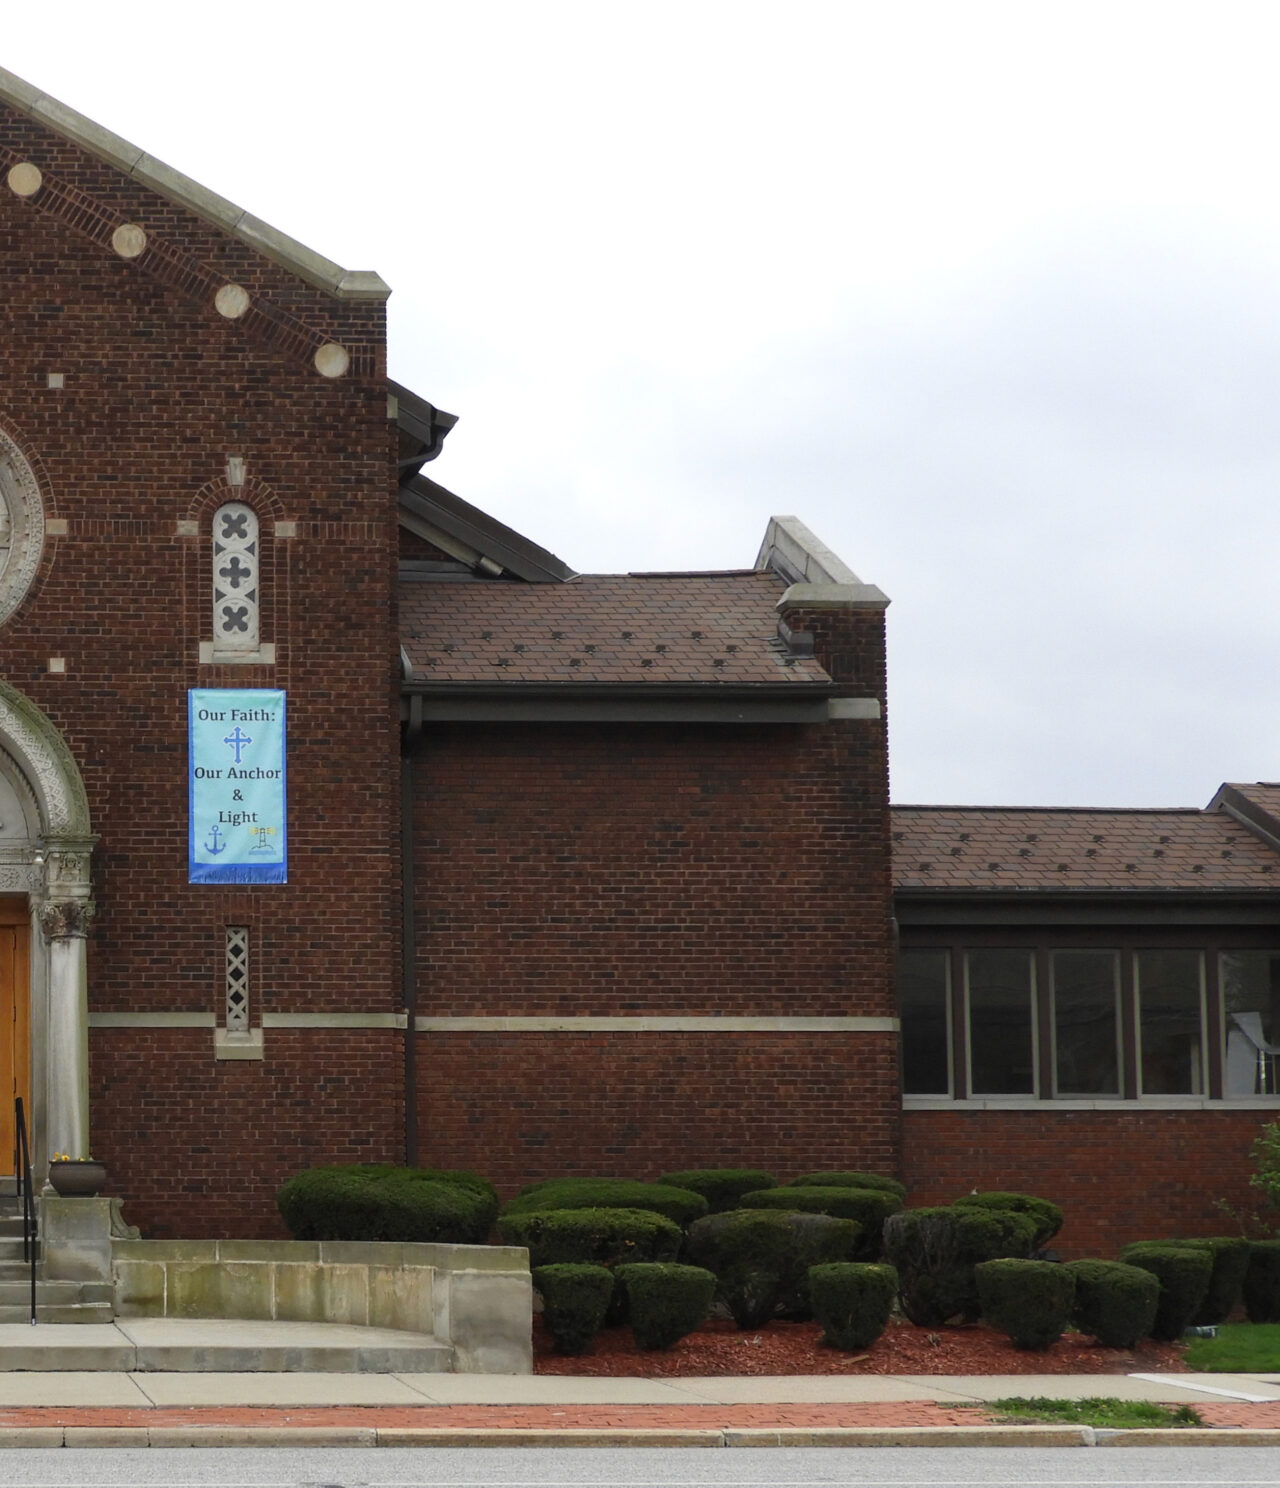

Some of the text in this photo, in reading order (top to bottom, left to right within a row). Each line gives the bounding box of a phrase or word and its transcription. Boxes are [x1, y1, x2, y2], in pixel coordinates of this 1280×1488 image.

[198, 709, 276, 722] Our Faith:
[195, 766, 282, 779] Our Anchor
[232, 789, 244, 801] &
[218, 811, 258, 826] Light
